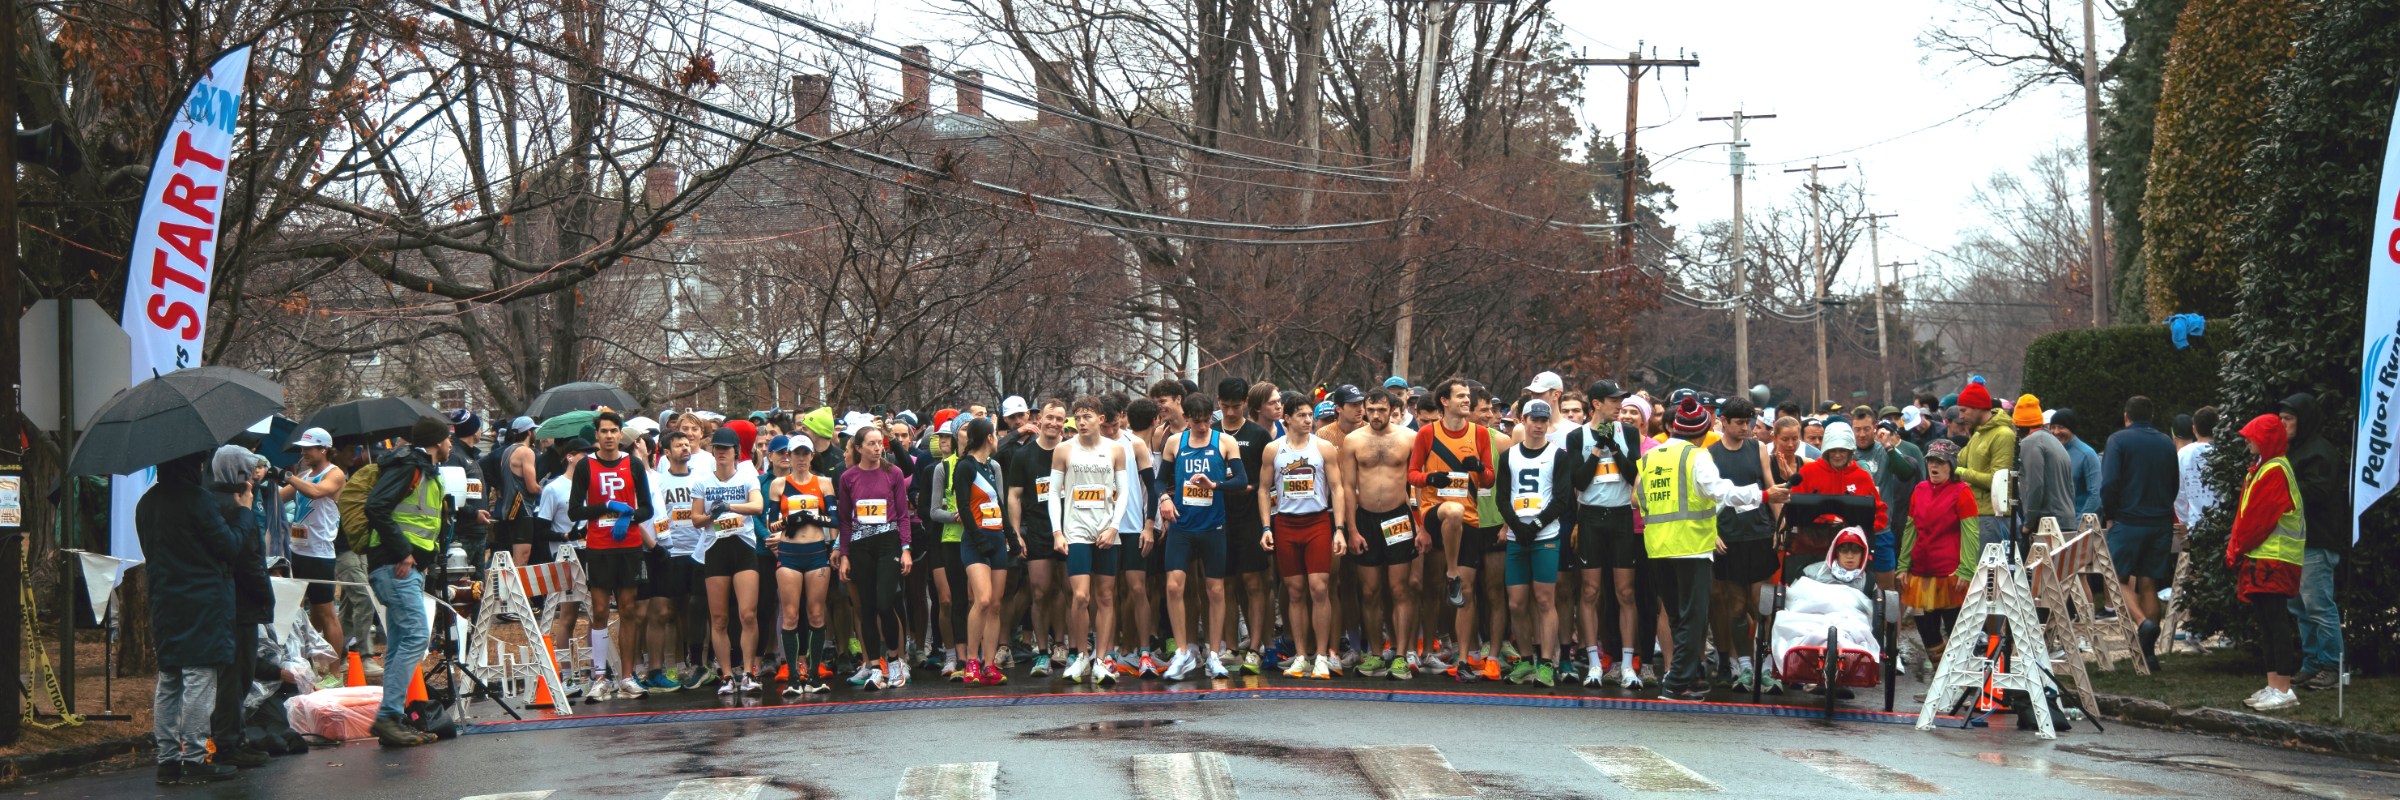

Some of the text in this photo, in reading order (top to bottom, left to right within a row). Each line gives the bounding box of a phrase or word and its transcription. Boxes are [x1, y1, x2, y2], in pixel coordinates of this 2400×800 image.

[147, 130, 226, 341] START
[2361, 390, 2393, 489] Pequot
[1185, 458, 1210, 473] USA
[1604, 464, 1609, 474] 1
[1289, 480, 1308, 491] 963
[1519, 468, 1539, 493] S
[1078, 490, 1100, 500] 2771
[1187, 487, 1209, 498] 2033
[1649, 491, 1670, 501] STAFF
[800, 499, 806, 509] 3
[1523, 498, 1529, 508] 9
[865, 505, 878, 516] 12
[991, 508, 996, 518] 2
[43, 665, 67, 715] CAUTION
